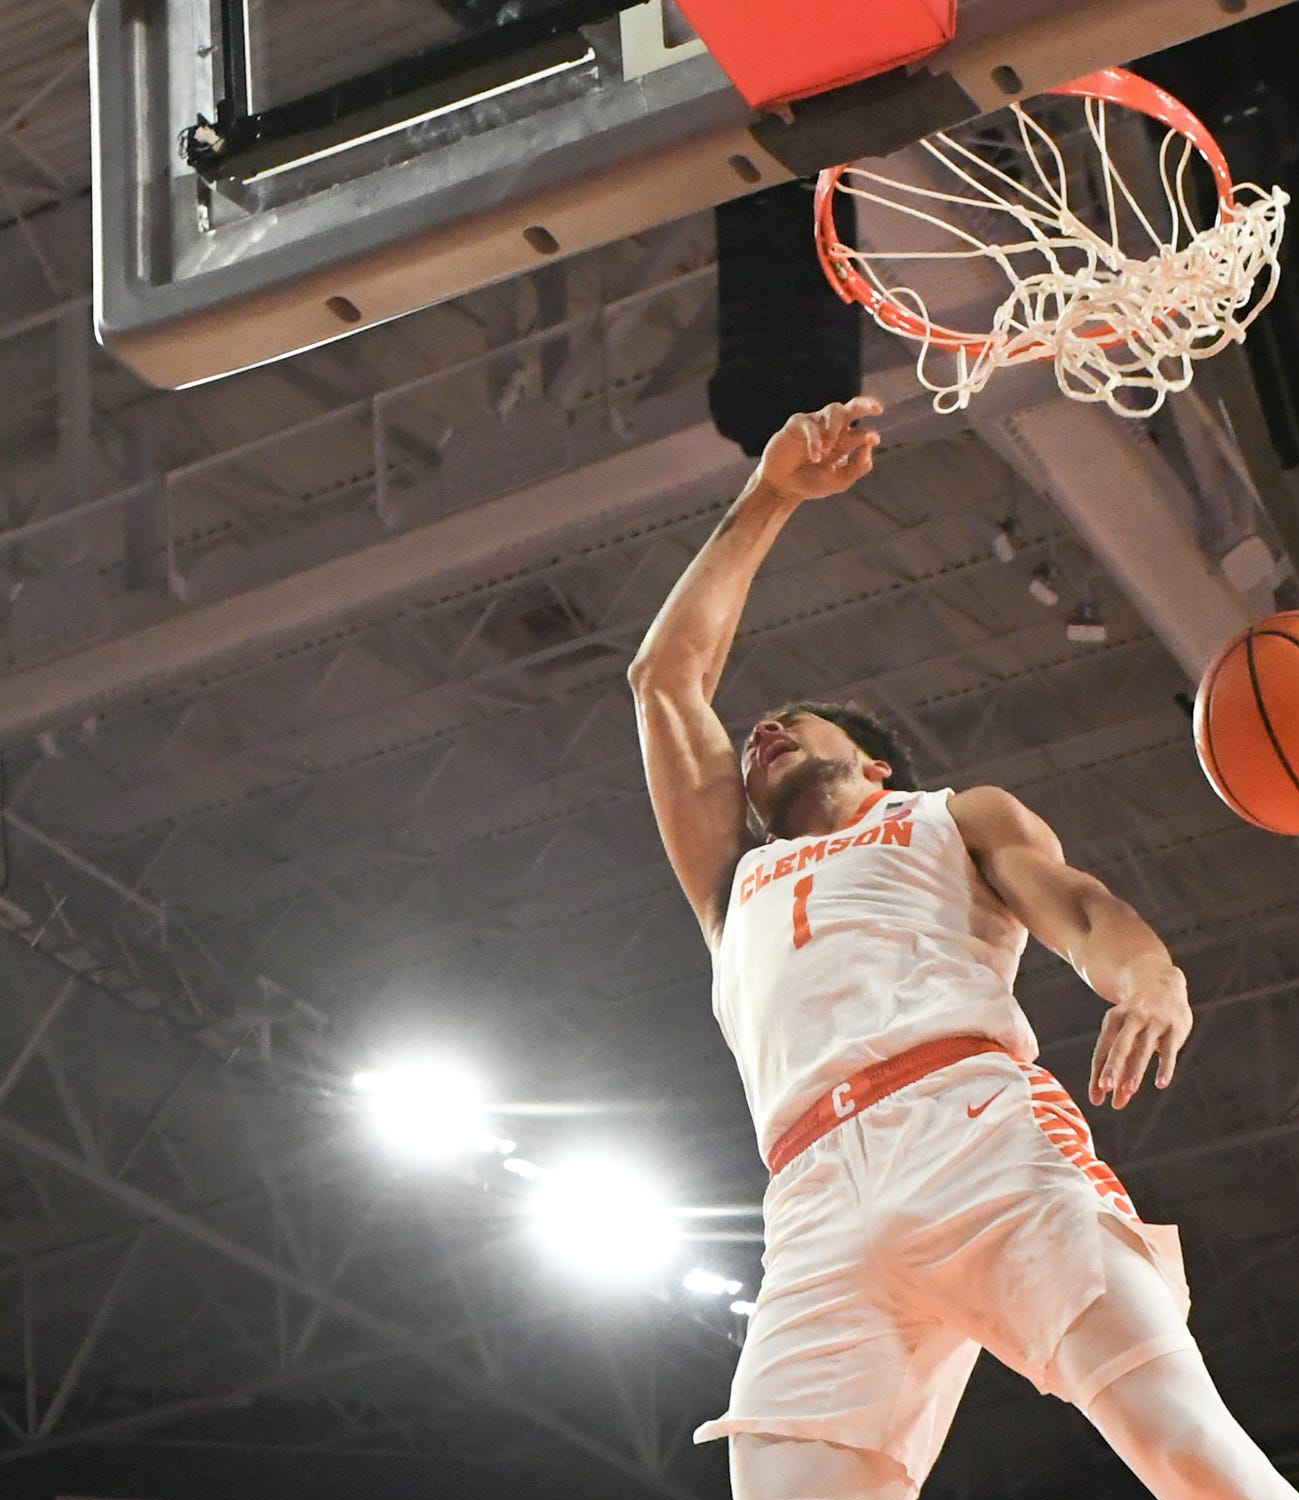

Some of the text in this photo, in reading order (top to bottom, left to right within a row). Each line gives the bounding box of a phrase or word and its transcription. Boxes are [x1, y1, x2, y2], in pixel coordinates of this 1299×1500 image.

[740, 821, 914, 906] CLEMSON
[792, 873, 814, 949] 1
[831, 1081, 856, 1118] C
